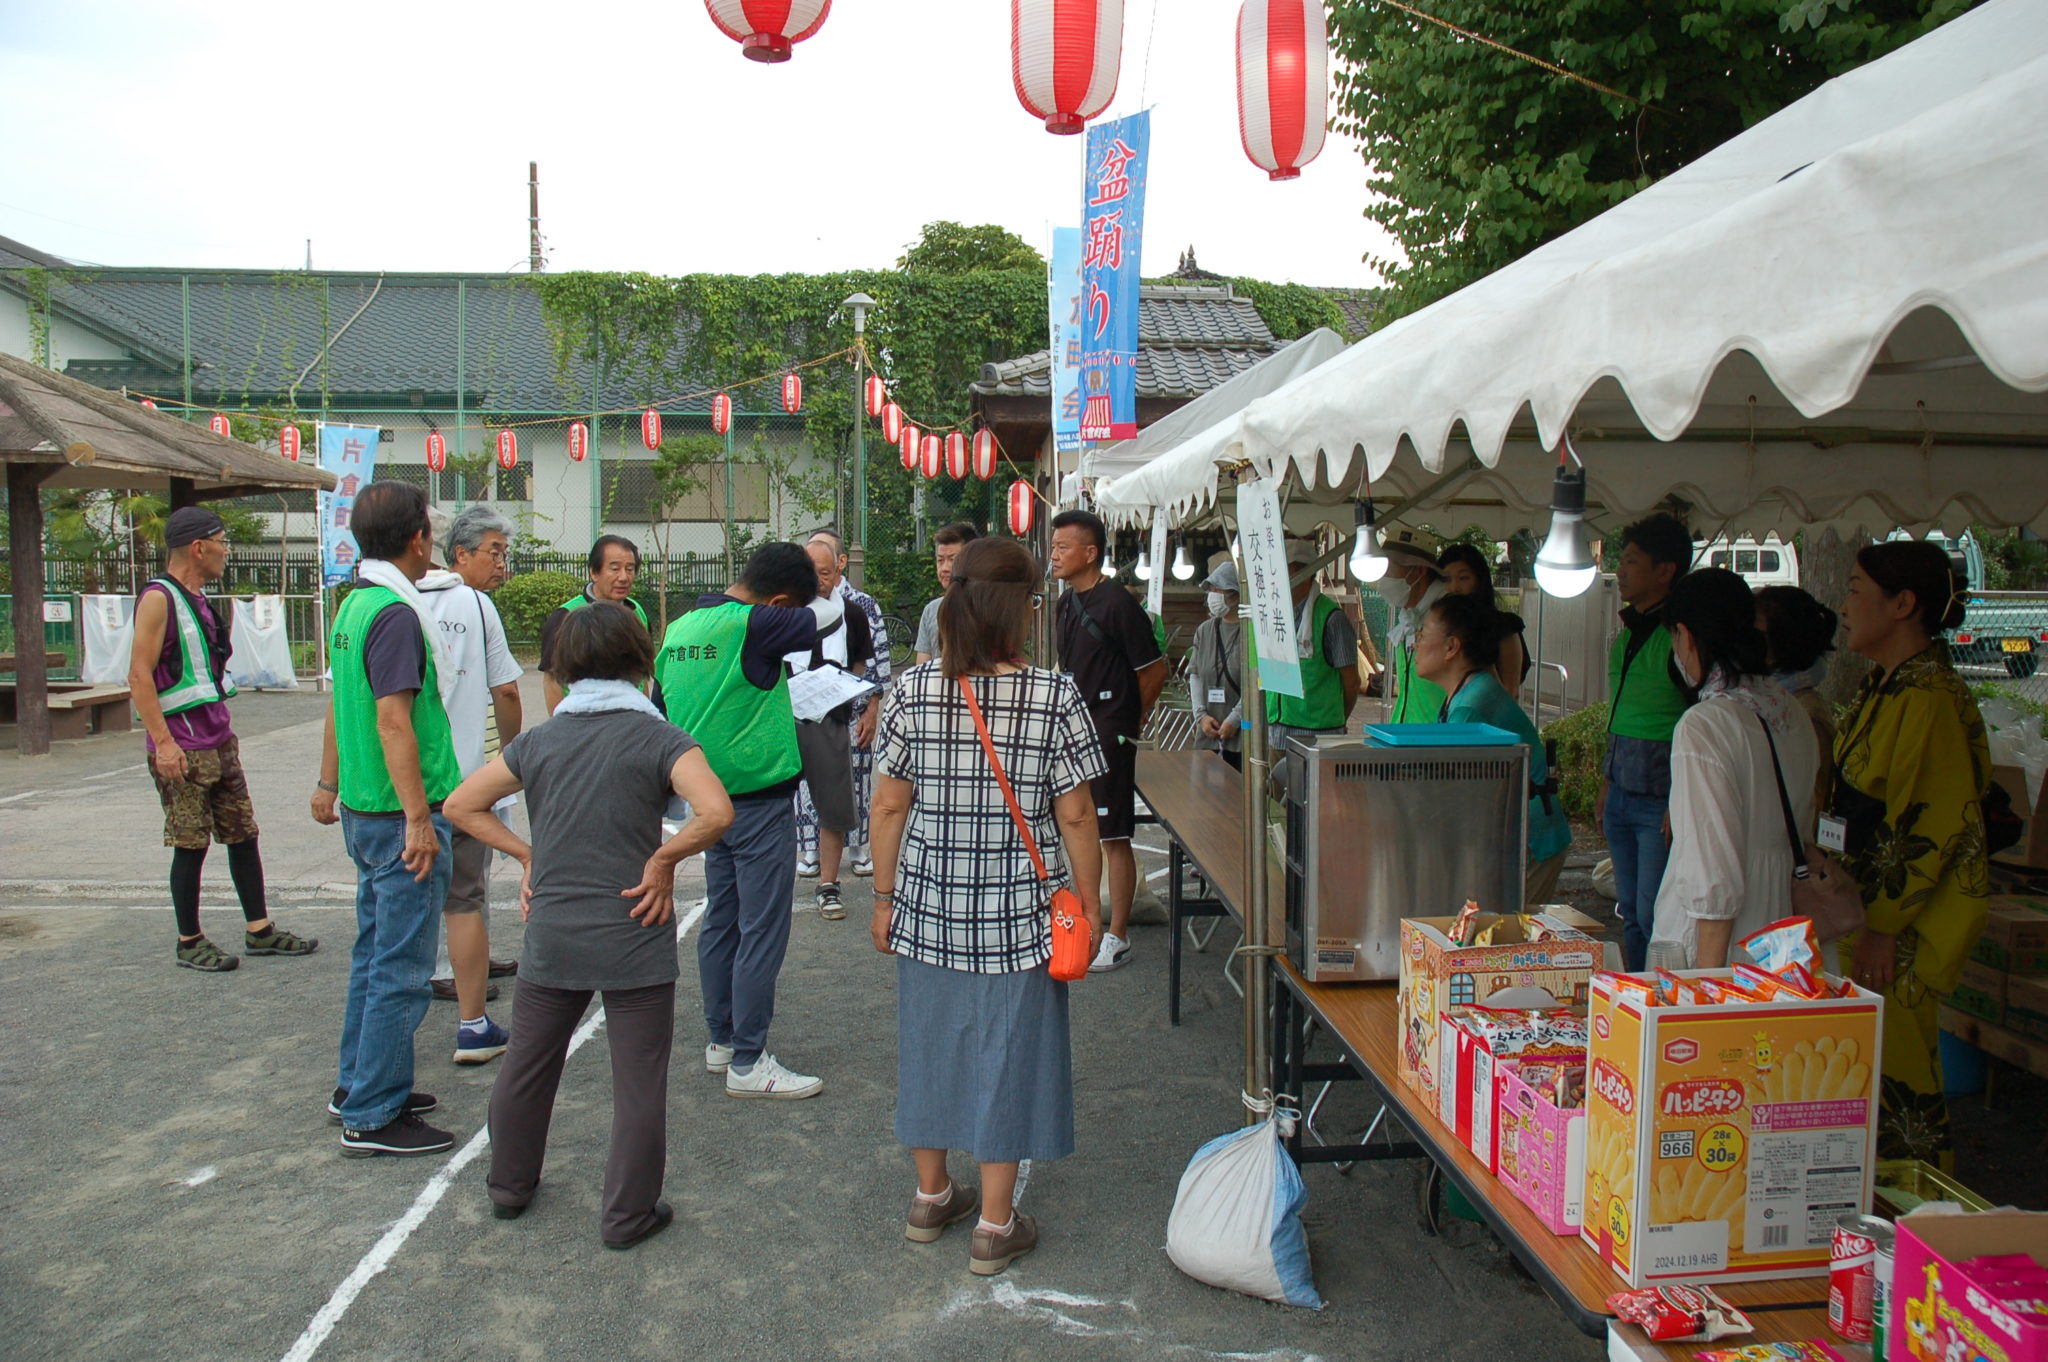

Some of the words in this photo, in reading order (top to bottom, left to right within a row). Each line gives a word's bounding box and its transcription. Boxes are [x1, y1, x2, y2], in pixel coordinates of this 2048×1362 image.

[1084, 138, 1136, 342] 盆踊り
[334, 437, 366, 565] 片倉町会
[438, 620, 467, 634] YO
[667, 643, 718, 663] 片倉町会
[1489, 1029, 1537, 1042] ビースター
[1663, 1087, 1742, 1114] ハッピーターン
[1662, 1142, 1691, 1156] 966
[1706, 1147, 1737, 1163] 30袋
[1655, 1254, 1698, 1269] 2024.12.19
